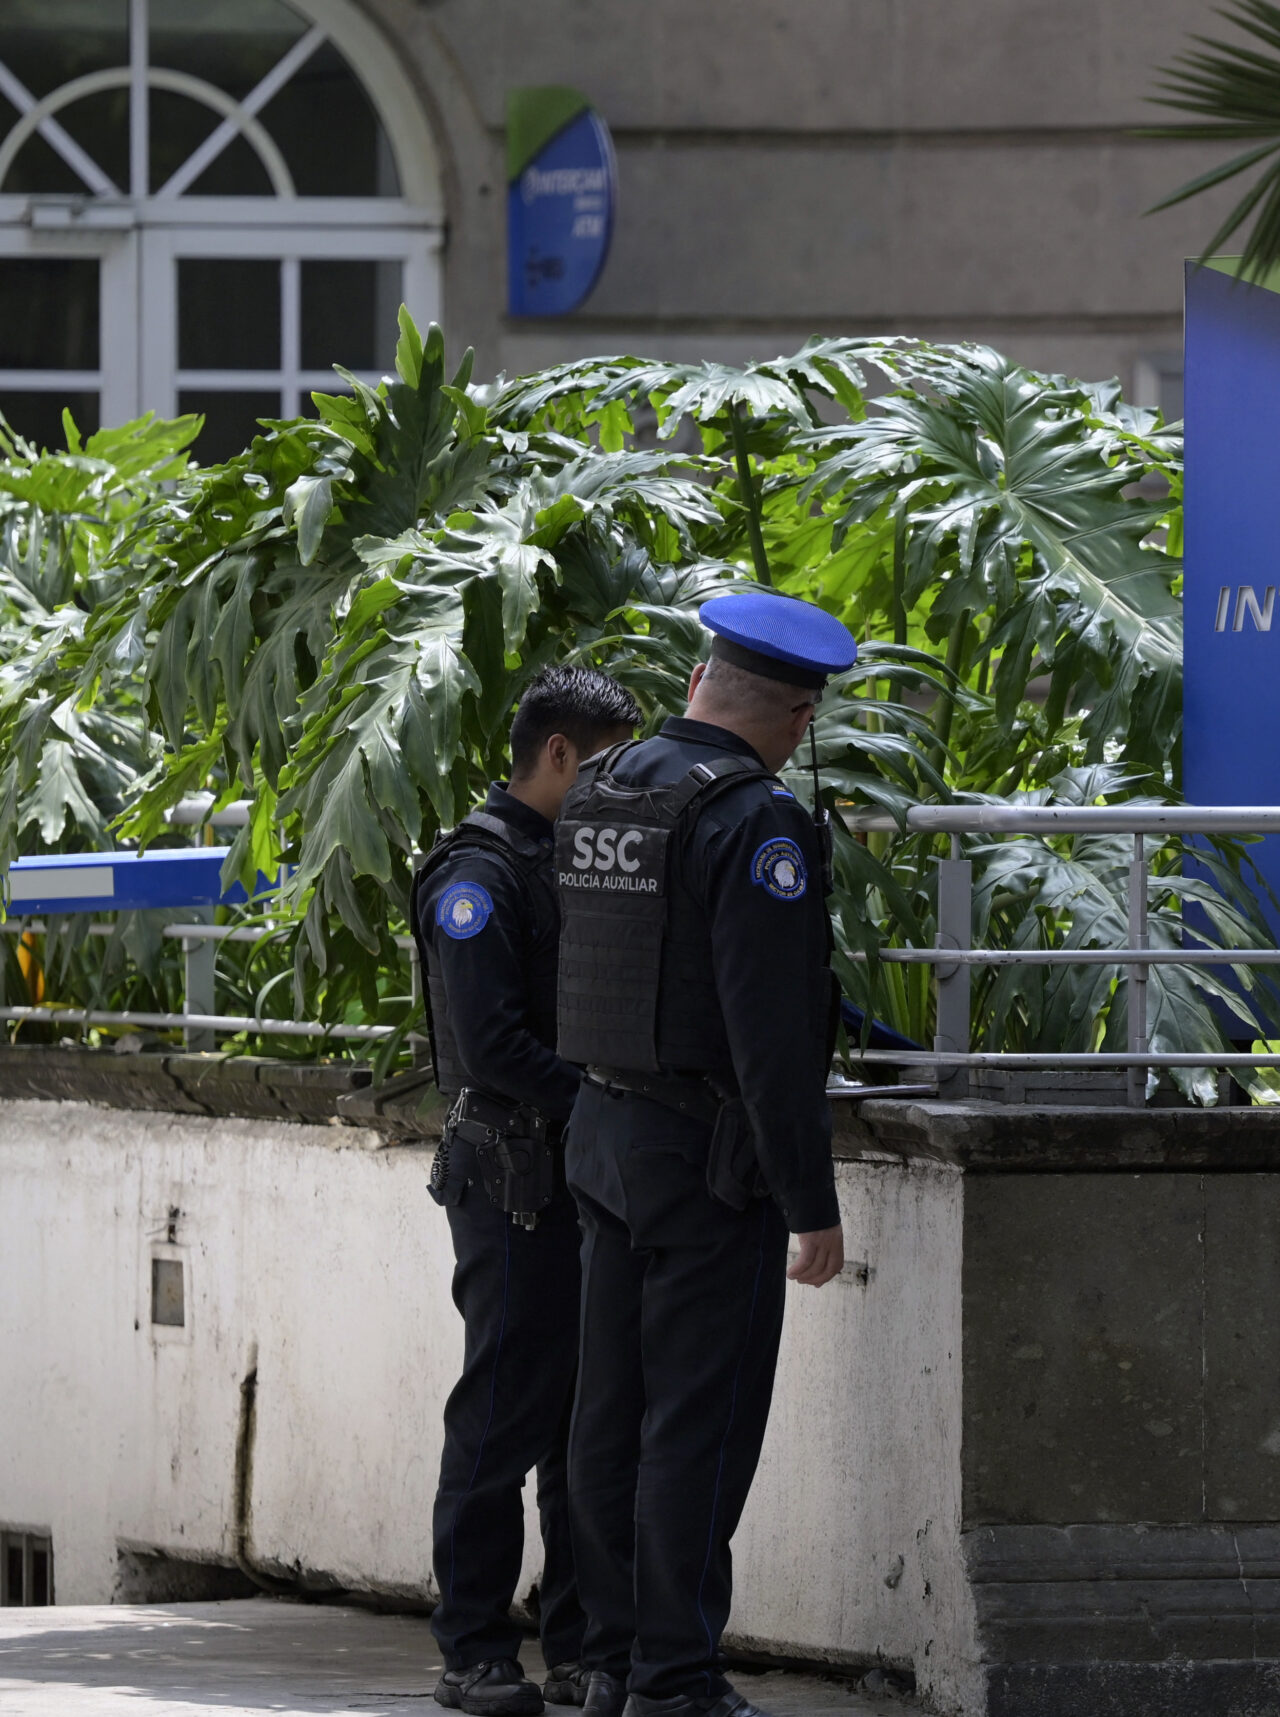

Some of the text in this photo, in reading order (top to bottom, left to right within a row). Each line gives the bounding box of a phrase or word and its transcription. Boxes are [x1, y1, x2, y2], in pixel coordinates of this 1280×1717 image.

[572, 827, 643, 873] SSC
[559, 871, 657, 892] POLICÍA AUXILIAR
